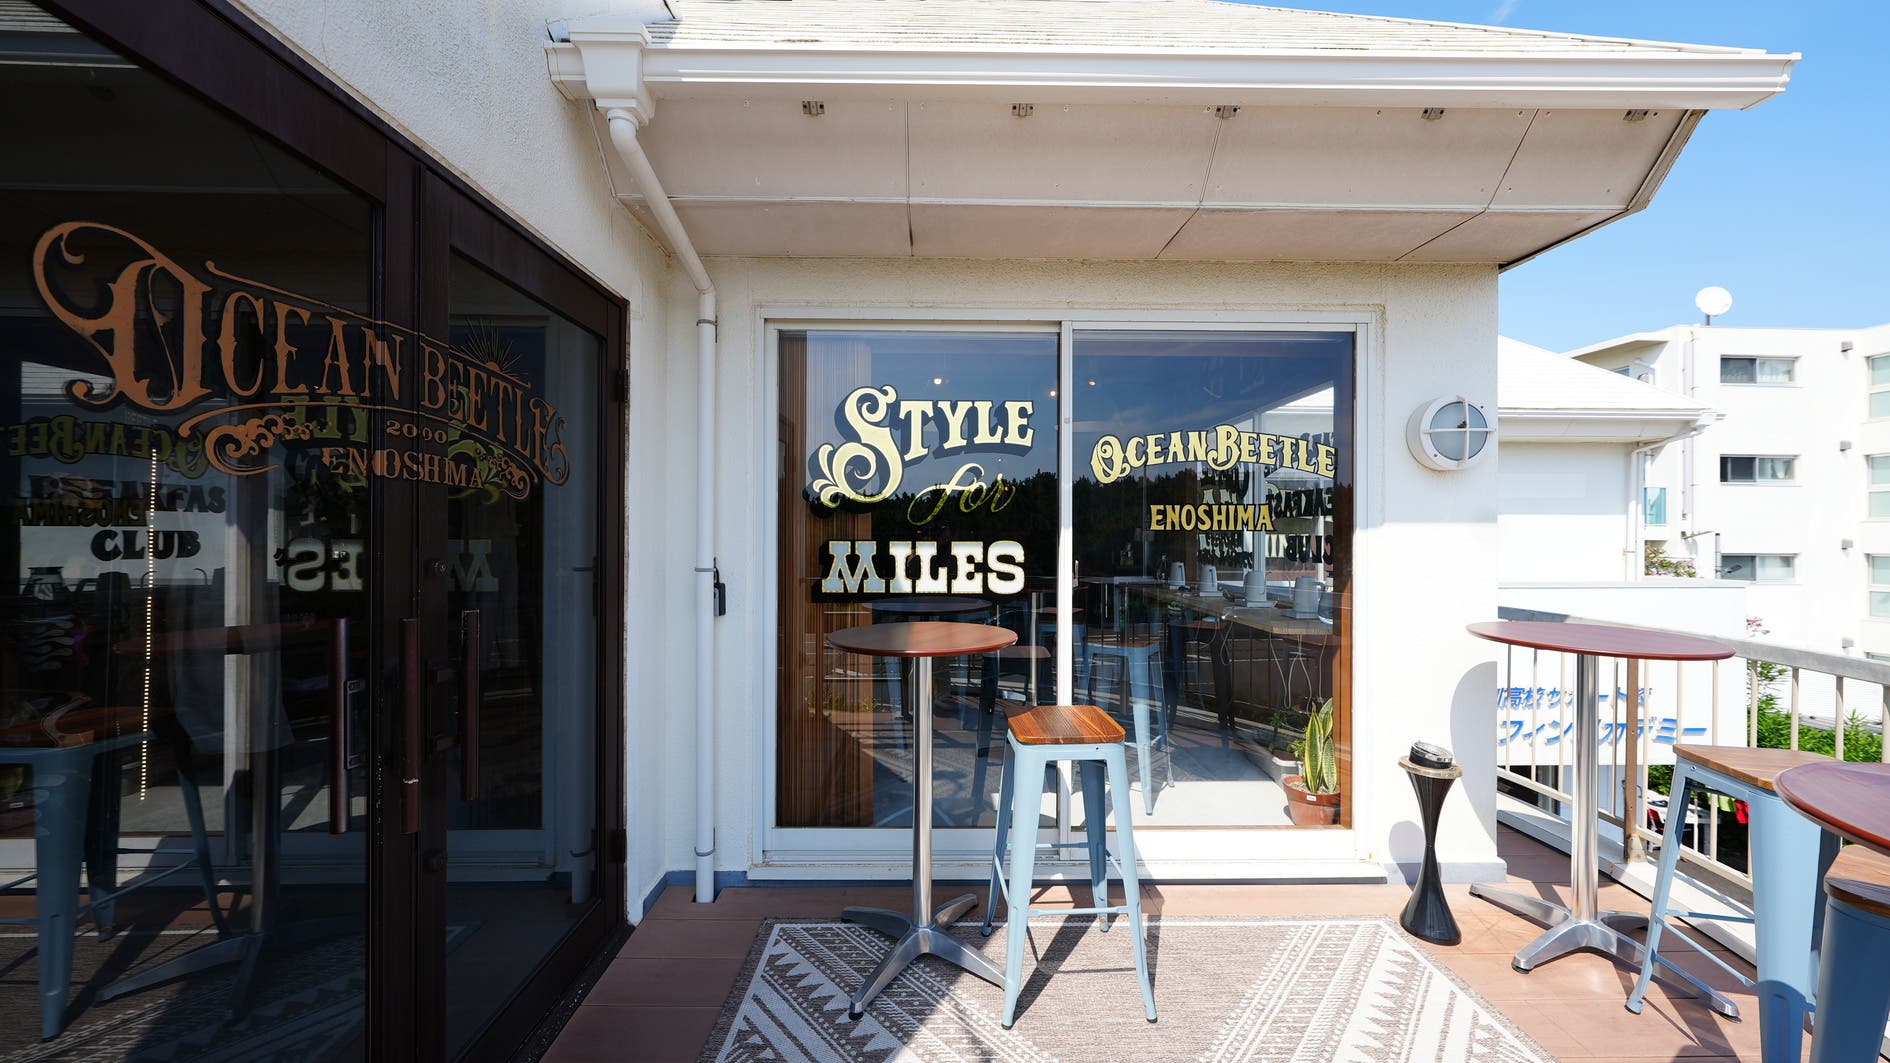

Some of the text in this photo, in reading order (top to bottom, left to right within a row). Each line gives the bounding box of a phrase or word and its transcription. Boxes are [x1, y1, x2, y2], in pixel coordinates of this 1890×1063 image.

[33, 221, 570, 486] OCEAN BEETLES
[386, 419, 447, 445] 2000
[812, 385, 1035, 509] STYLE
[1090, 423, 1337, 484] OCEAN BEETLE
[907, 462, 1016, 527] for
[1150, 504, 1276, 531] ENOSHIMA
[91, 529, 202, 561] CLUB
[820, 541, 1026, 595] MILES
